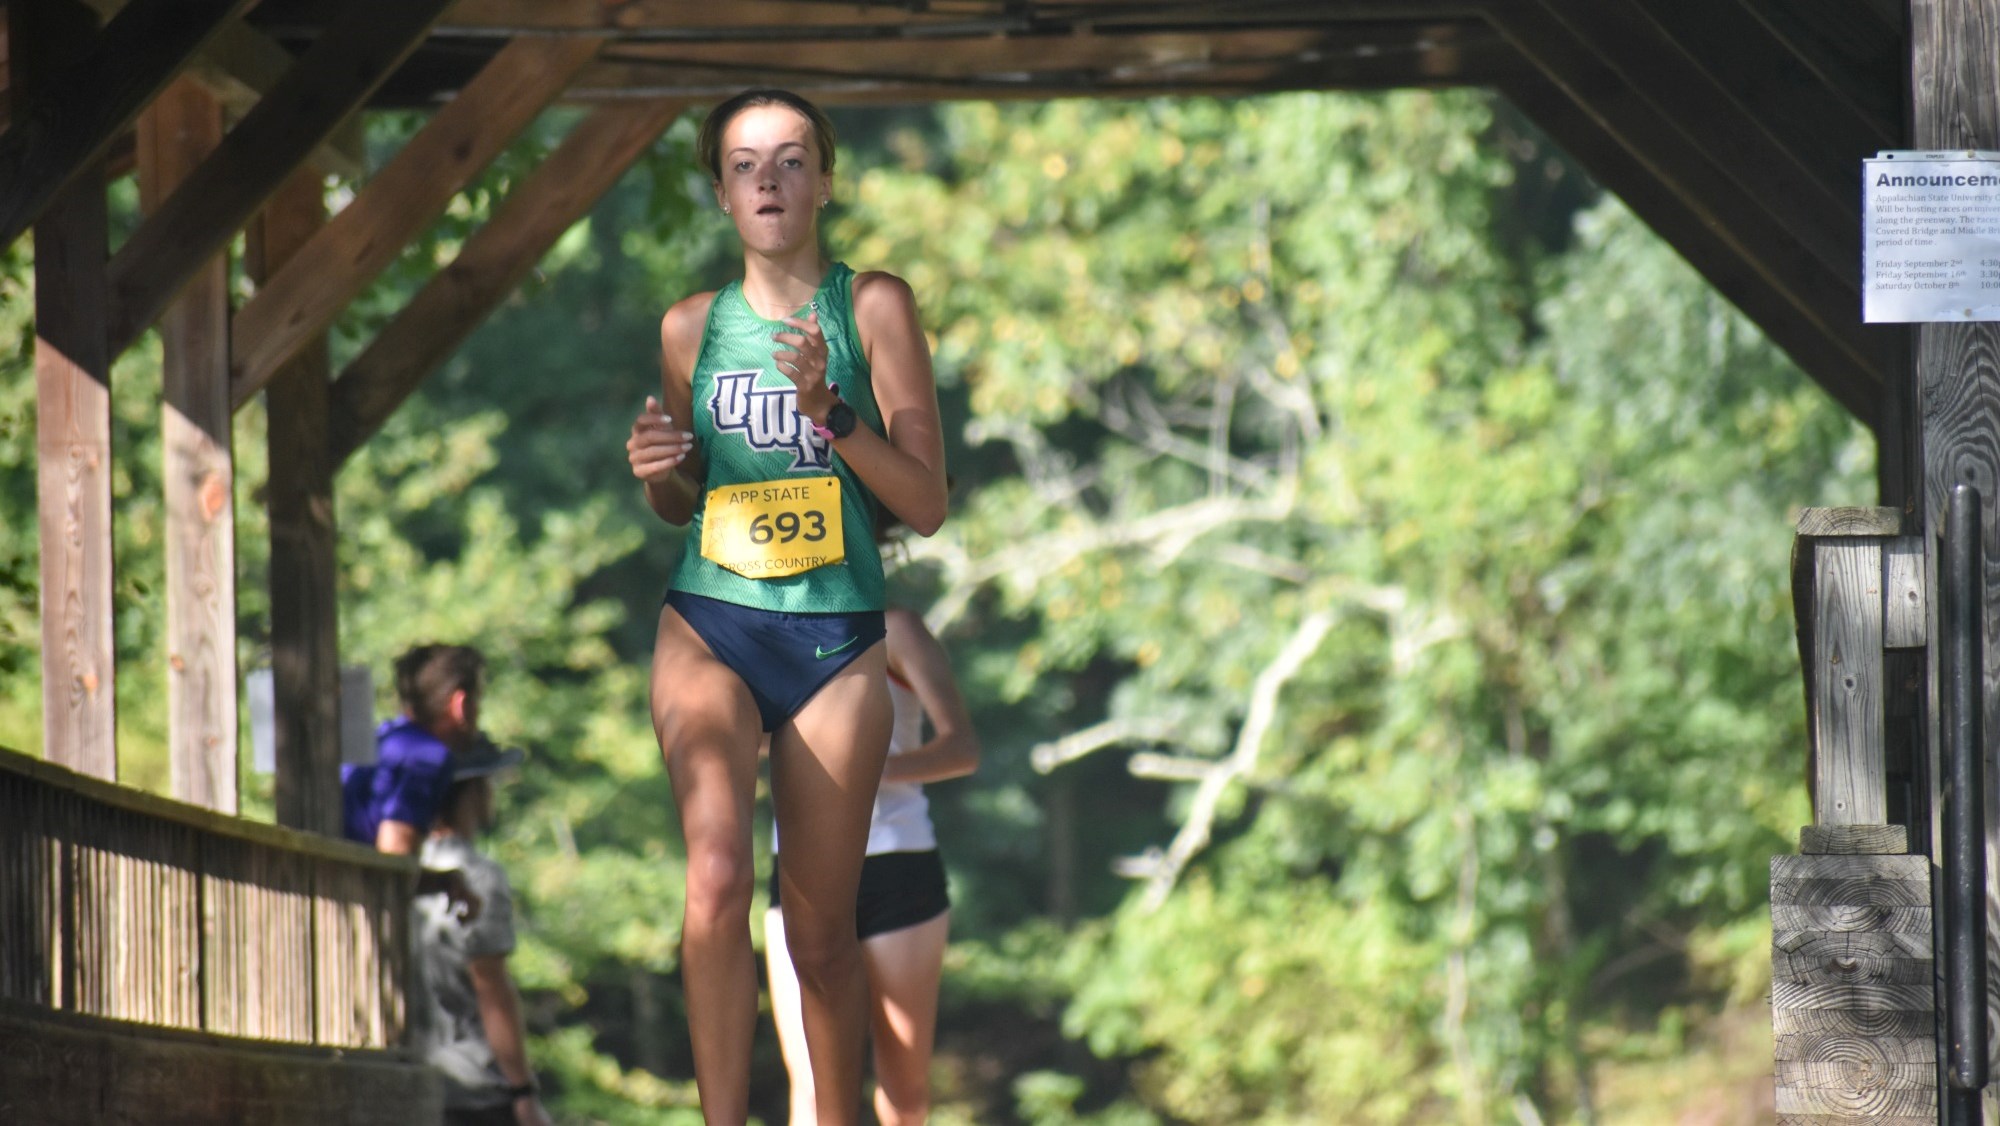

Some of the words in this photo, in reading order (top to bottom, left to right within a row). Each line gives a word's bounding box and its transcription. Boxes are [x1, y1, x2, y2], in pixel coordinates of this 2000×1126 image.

[1876, 172, 2000, 187] Announcem
[1876, 193, 1926, 203] Appalachian
[1929, 193, 1949, 201] State
[1951, 193, 1992, 202] University
[1895, 205, 1904, 213] be
[1907, 205, 1937, 216] hosting
[1876, 216, 1898, 225] along
[1900, 216, 1913, 224] the
[1915, 216, 1957, 226] greenway.
[1960, 215, 1974, 223] The
[1876, 227, 1909, 235] Covered
[1912, 227, 1939, 236] Bridge
[1941, 227, 1956, 235] and
[1959, 226, 1986, 235] Middle
[1876, 238, 1903, 248] period
[1876, 260, 1902, 269] Friday
[1904, 259, 1949, 270] September
[1876, 271, 1902, 280] Friday
[1904, 270, 1948, 280] September
[1876, 282, 1912, 291] Saturday
[1914, 281, 1946, 290] October
[729, 490, 759, 505] APP
[763, 486, 811, 502] STATE
[749, 510, 827, 545] 693
[764, 556, 827, 570] COUNTRY
